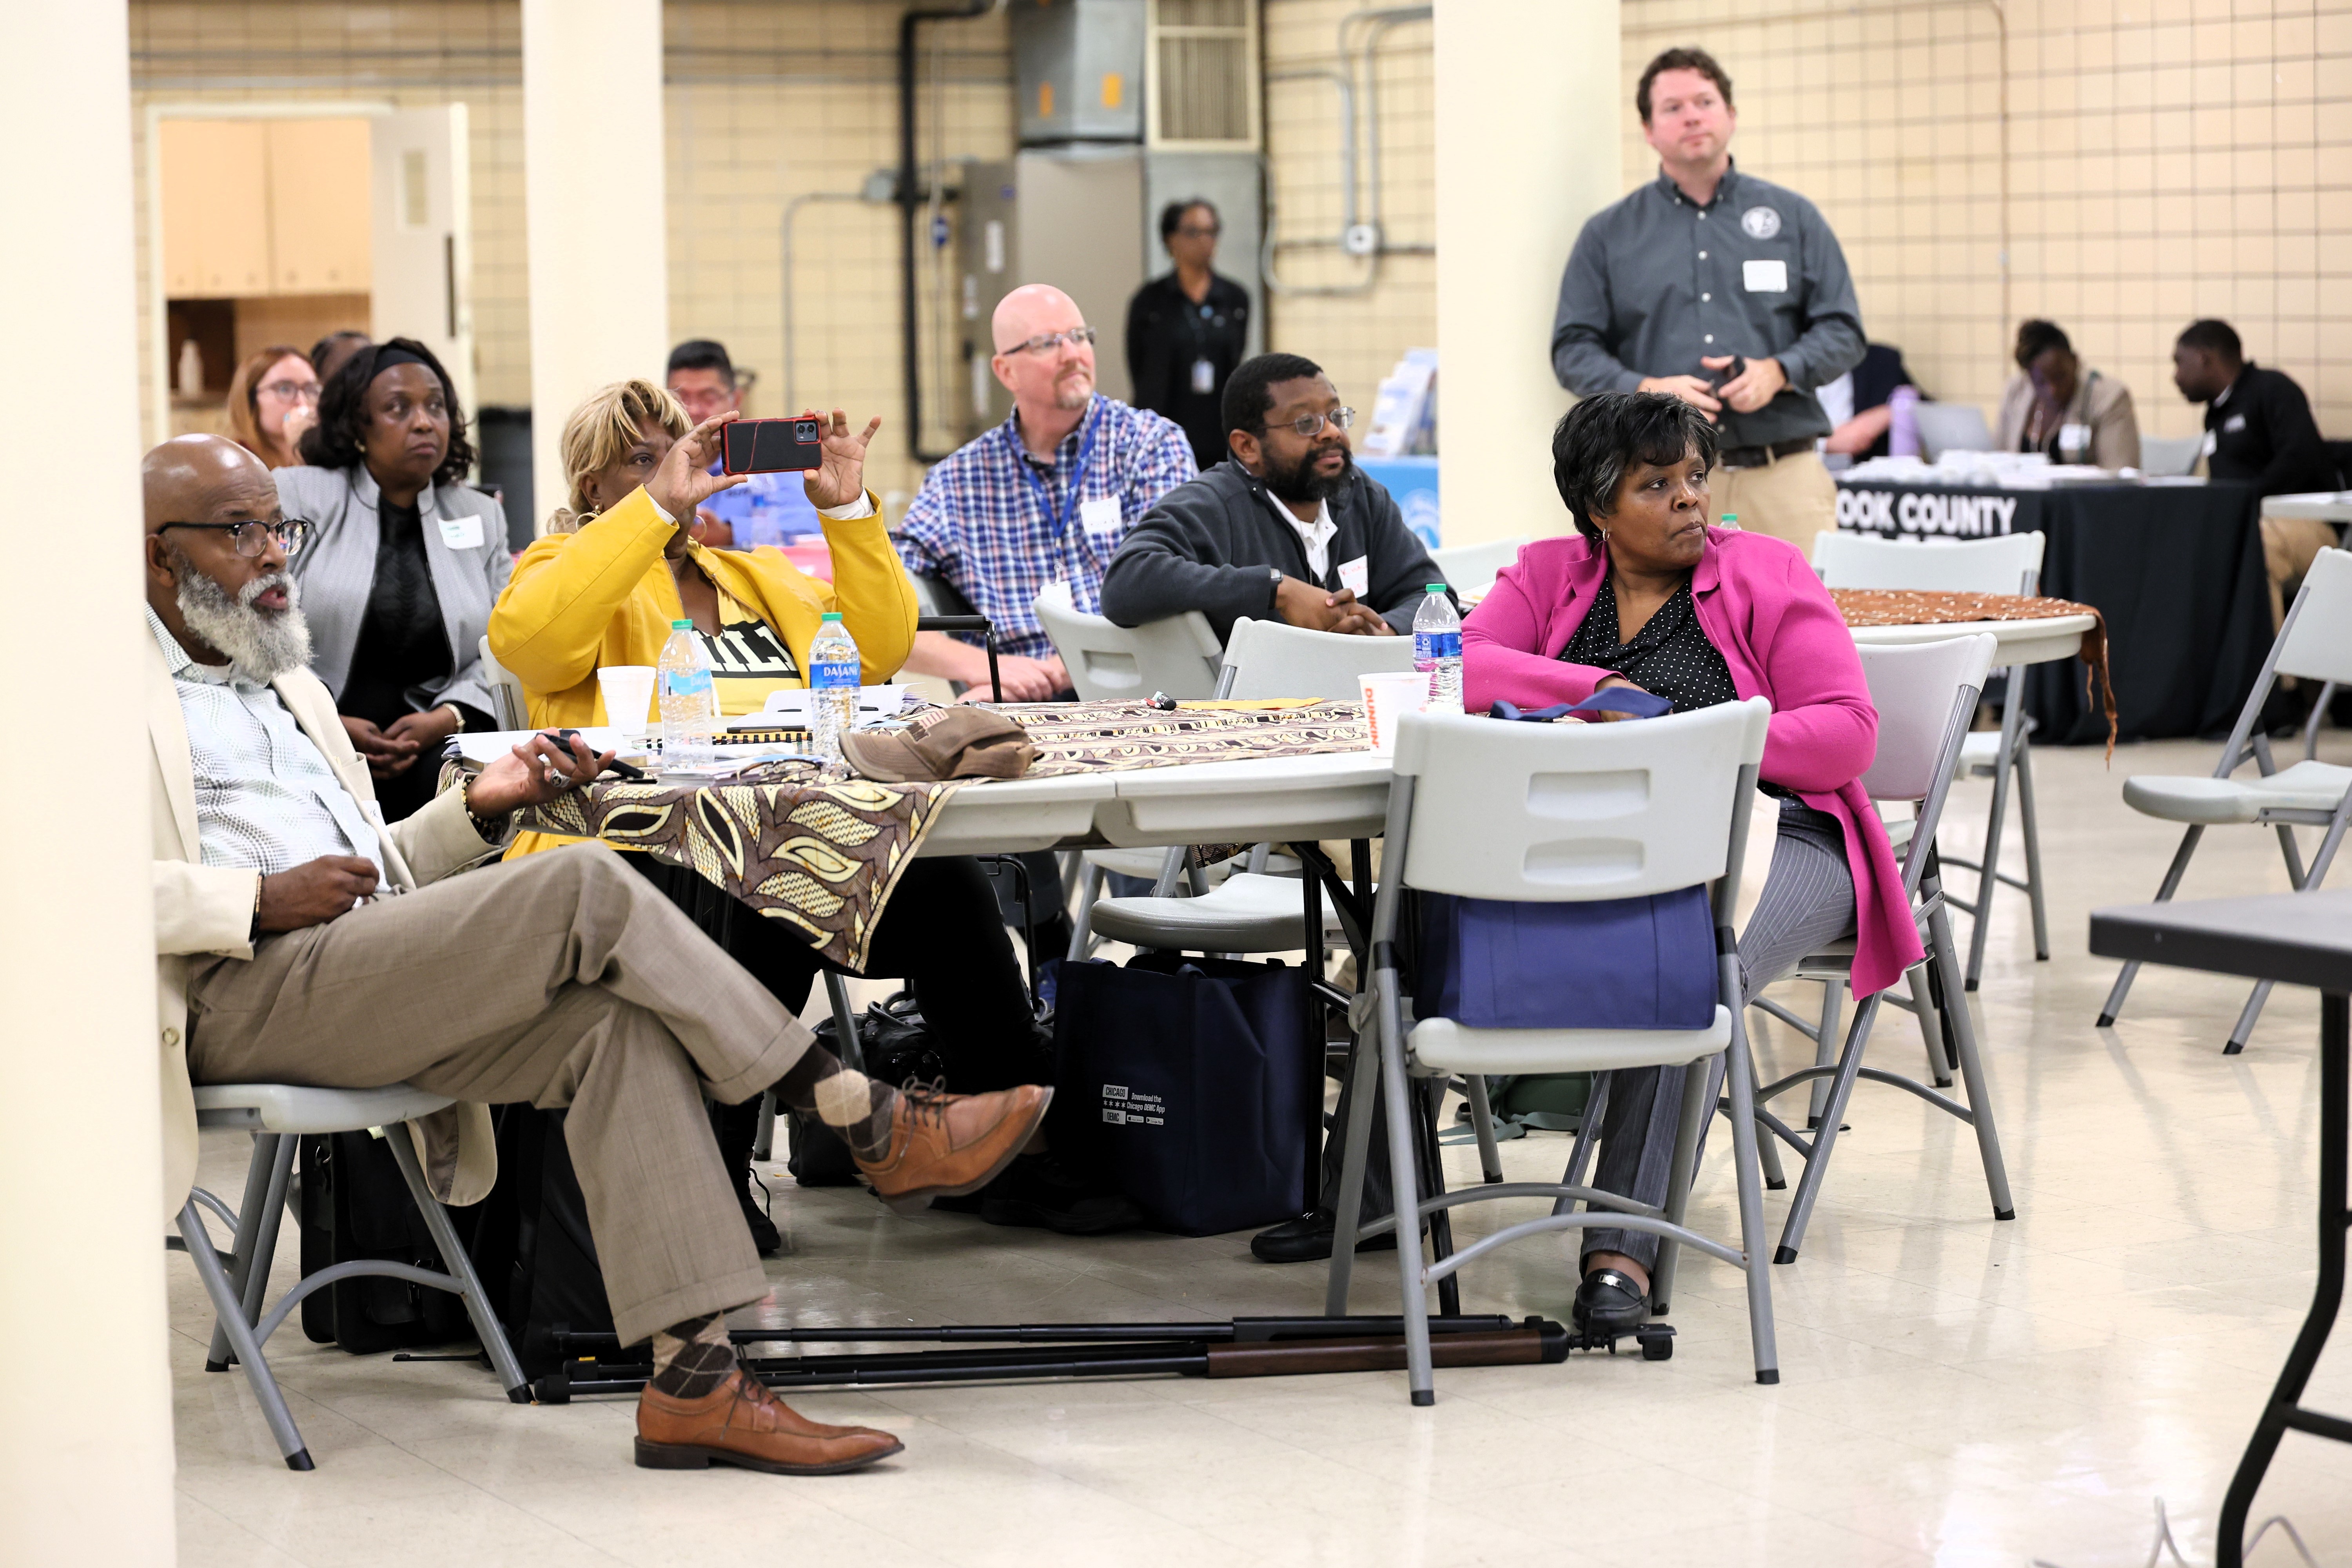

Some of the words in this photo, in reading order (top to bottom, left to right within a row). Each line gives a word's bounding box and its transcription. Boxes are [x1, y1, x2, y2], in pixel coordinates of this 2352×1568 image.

[1836, 488, 1896, 532] OOK
[1897, 492, 2017, 536] COUNTY
[1106, 1087, 1125, 1097] CHICAGO
[1131, 1093, 1153, 1102] Download
[1127, 1102, 1143, 1111] Chicago
[1156, 1105, 1165, 1114] App
[1107, 1112, 1119, 1122] OEMC
